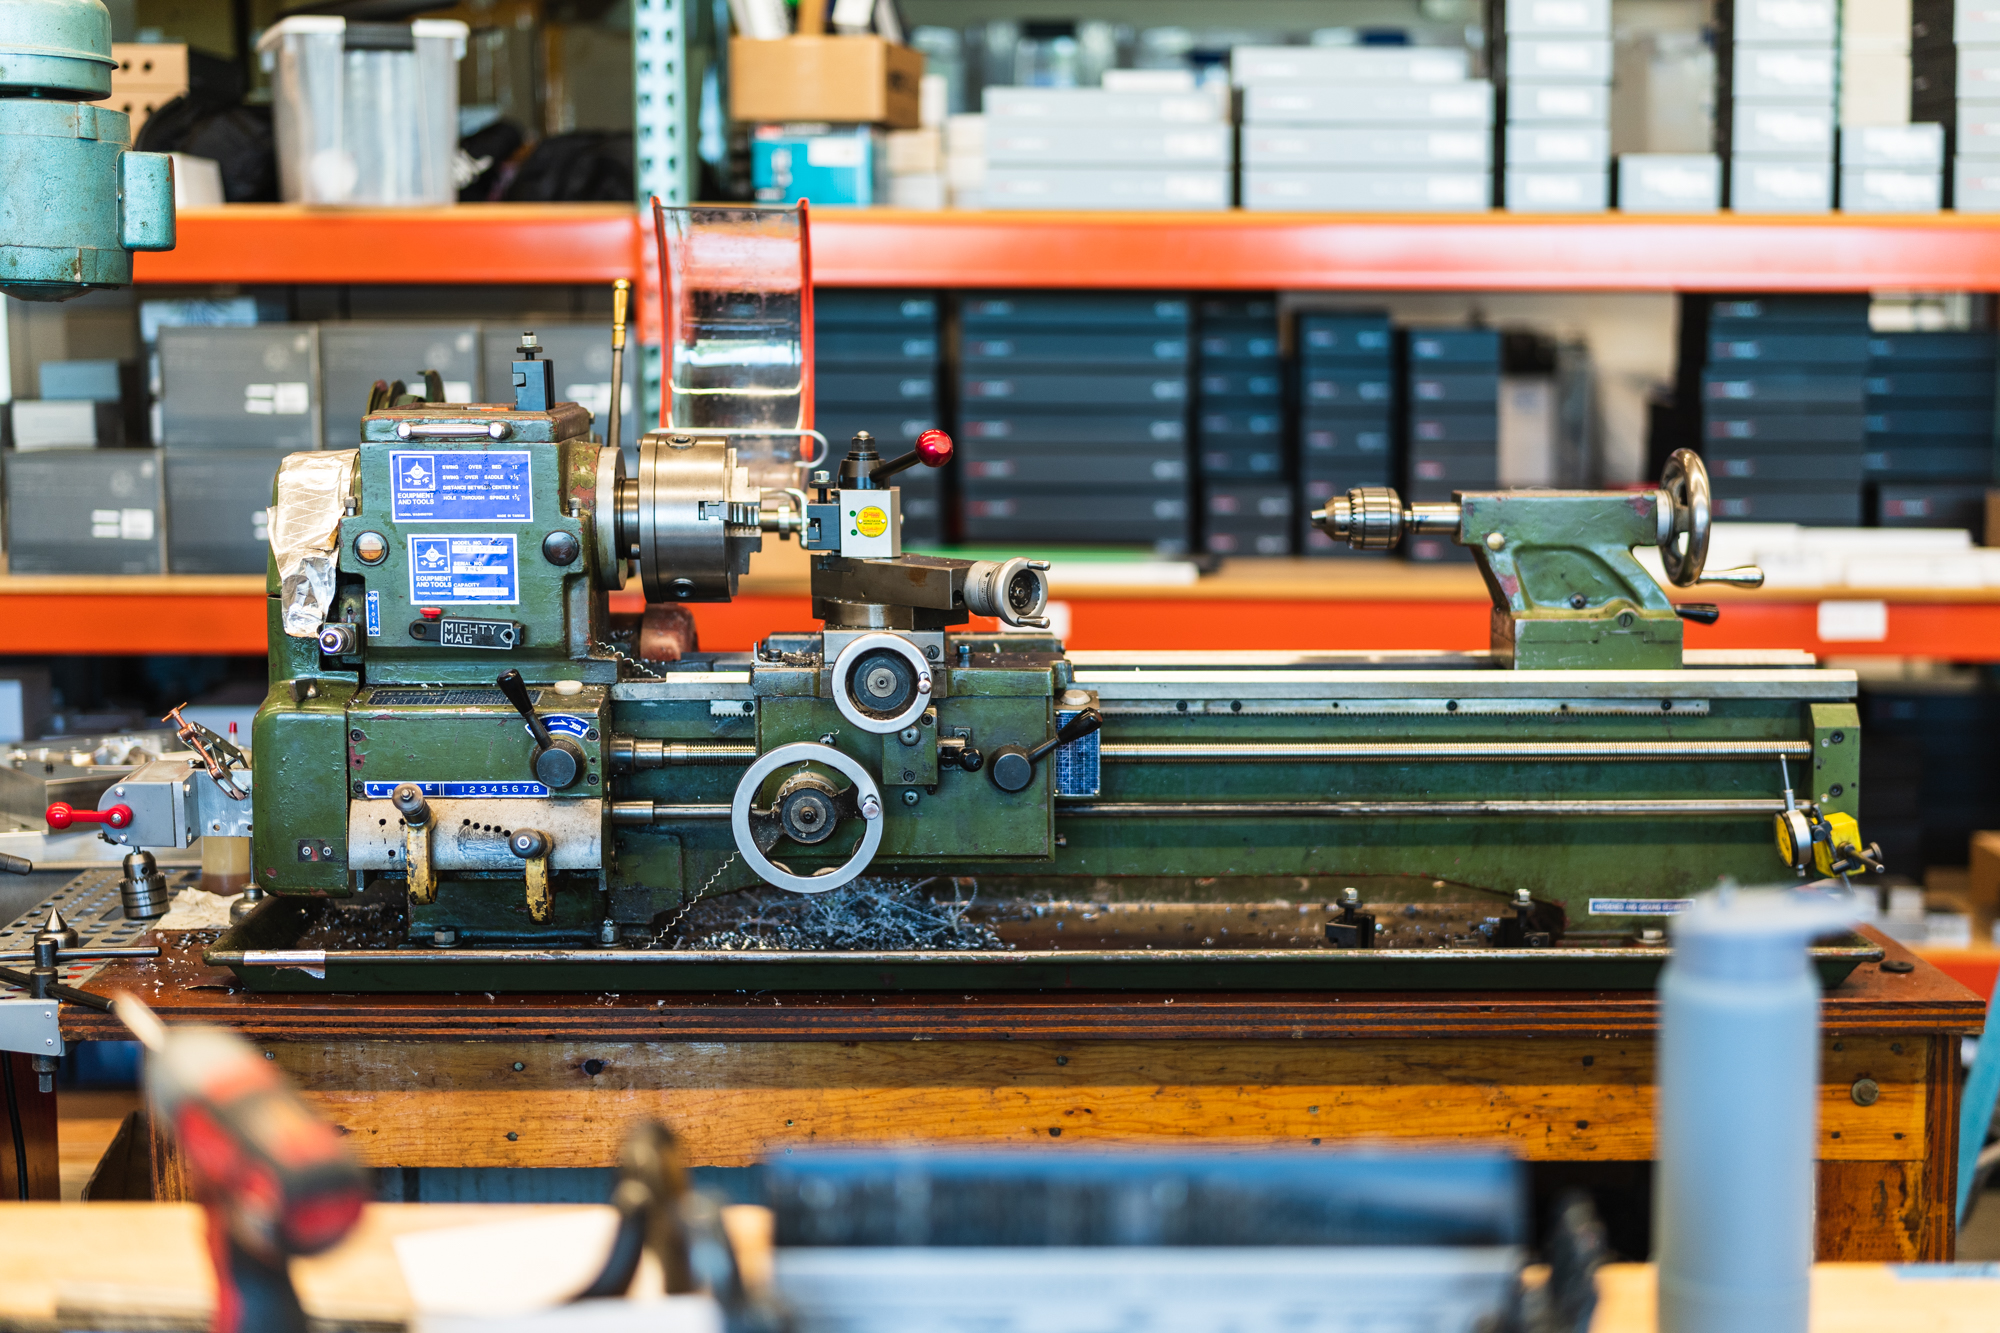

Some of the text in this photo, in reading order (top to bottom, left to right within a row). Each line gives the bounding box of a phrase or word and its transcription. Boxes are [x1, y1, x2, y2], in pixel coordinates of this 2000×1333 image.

[444, 622, 497, 635] MIGHTY
[444, 633, 473, 644] MAG
[425, 783, 433, 791] E
[1625, 902, 1637, 911] AND
[1638, 902, 1661, 911] GROUND
